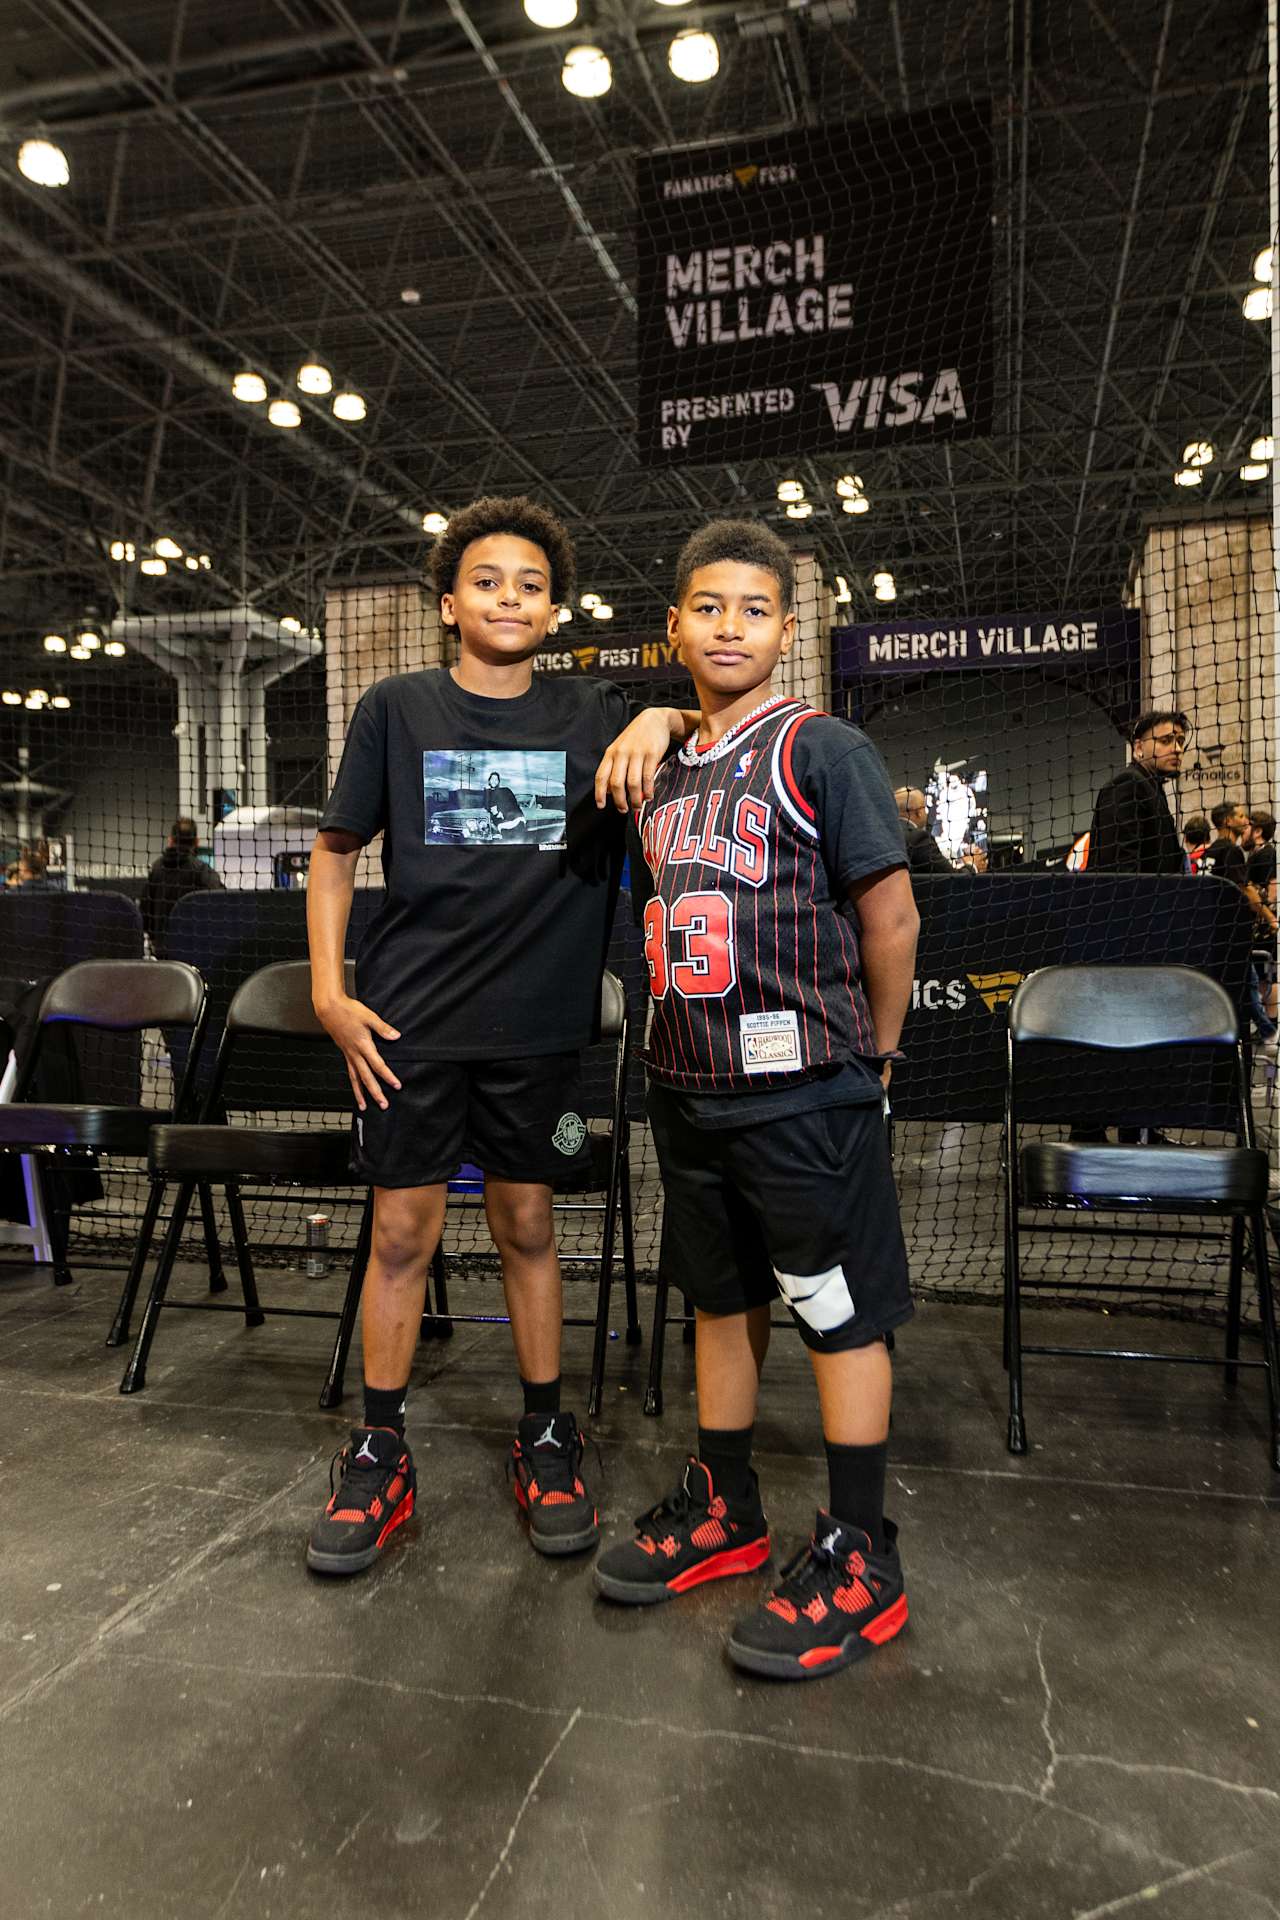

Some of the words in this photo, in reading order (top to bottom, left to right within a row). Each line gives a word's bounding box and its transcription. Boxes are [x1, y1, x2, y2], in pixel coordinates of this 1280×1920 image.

[666, 235, 824, 298] MERCH
[664, 284, 854, 348] VILLAGE
[661, 388, 795, 423] PRESENTED
[811, 368, 967, 432] VISA
[661, 424, 691, 449] BY
[532, 652, 573, 671] ATICS
[600, 647, 640, 668] FEST
[869, 629, 967, 662] MERCH
[977, 622, 1098, 656] VILLAGE
[643, 890, 737, 1000] 33
[912, 979, 966, 1010] ICS
